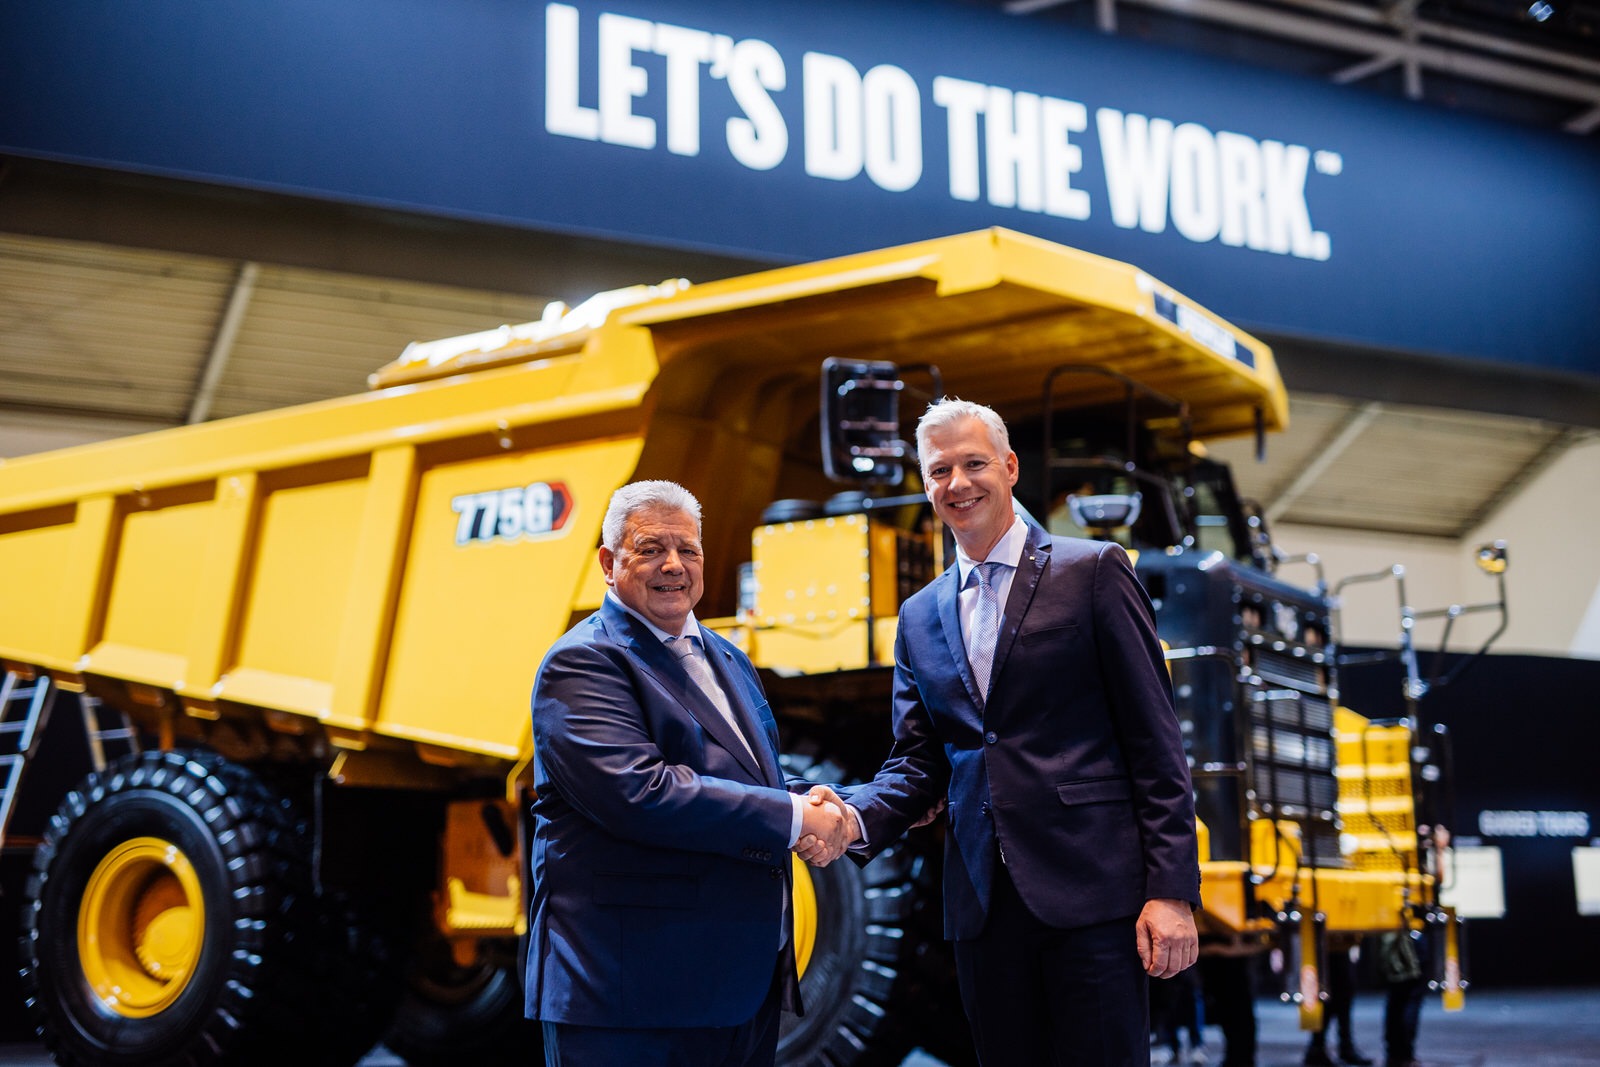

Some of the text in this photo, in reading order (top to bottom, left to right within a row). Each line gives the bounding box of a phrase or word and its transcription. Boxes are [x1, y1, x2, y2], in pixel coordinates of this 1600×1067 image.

[545, 3, 788, 170] LET'S
[803, 51, 923, 191] DO
[933, 76, 1091, 220] THE
[452, 482, 553, 546] 775G
